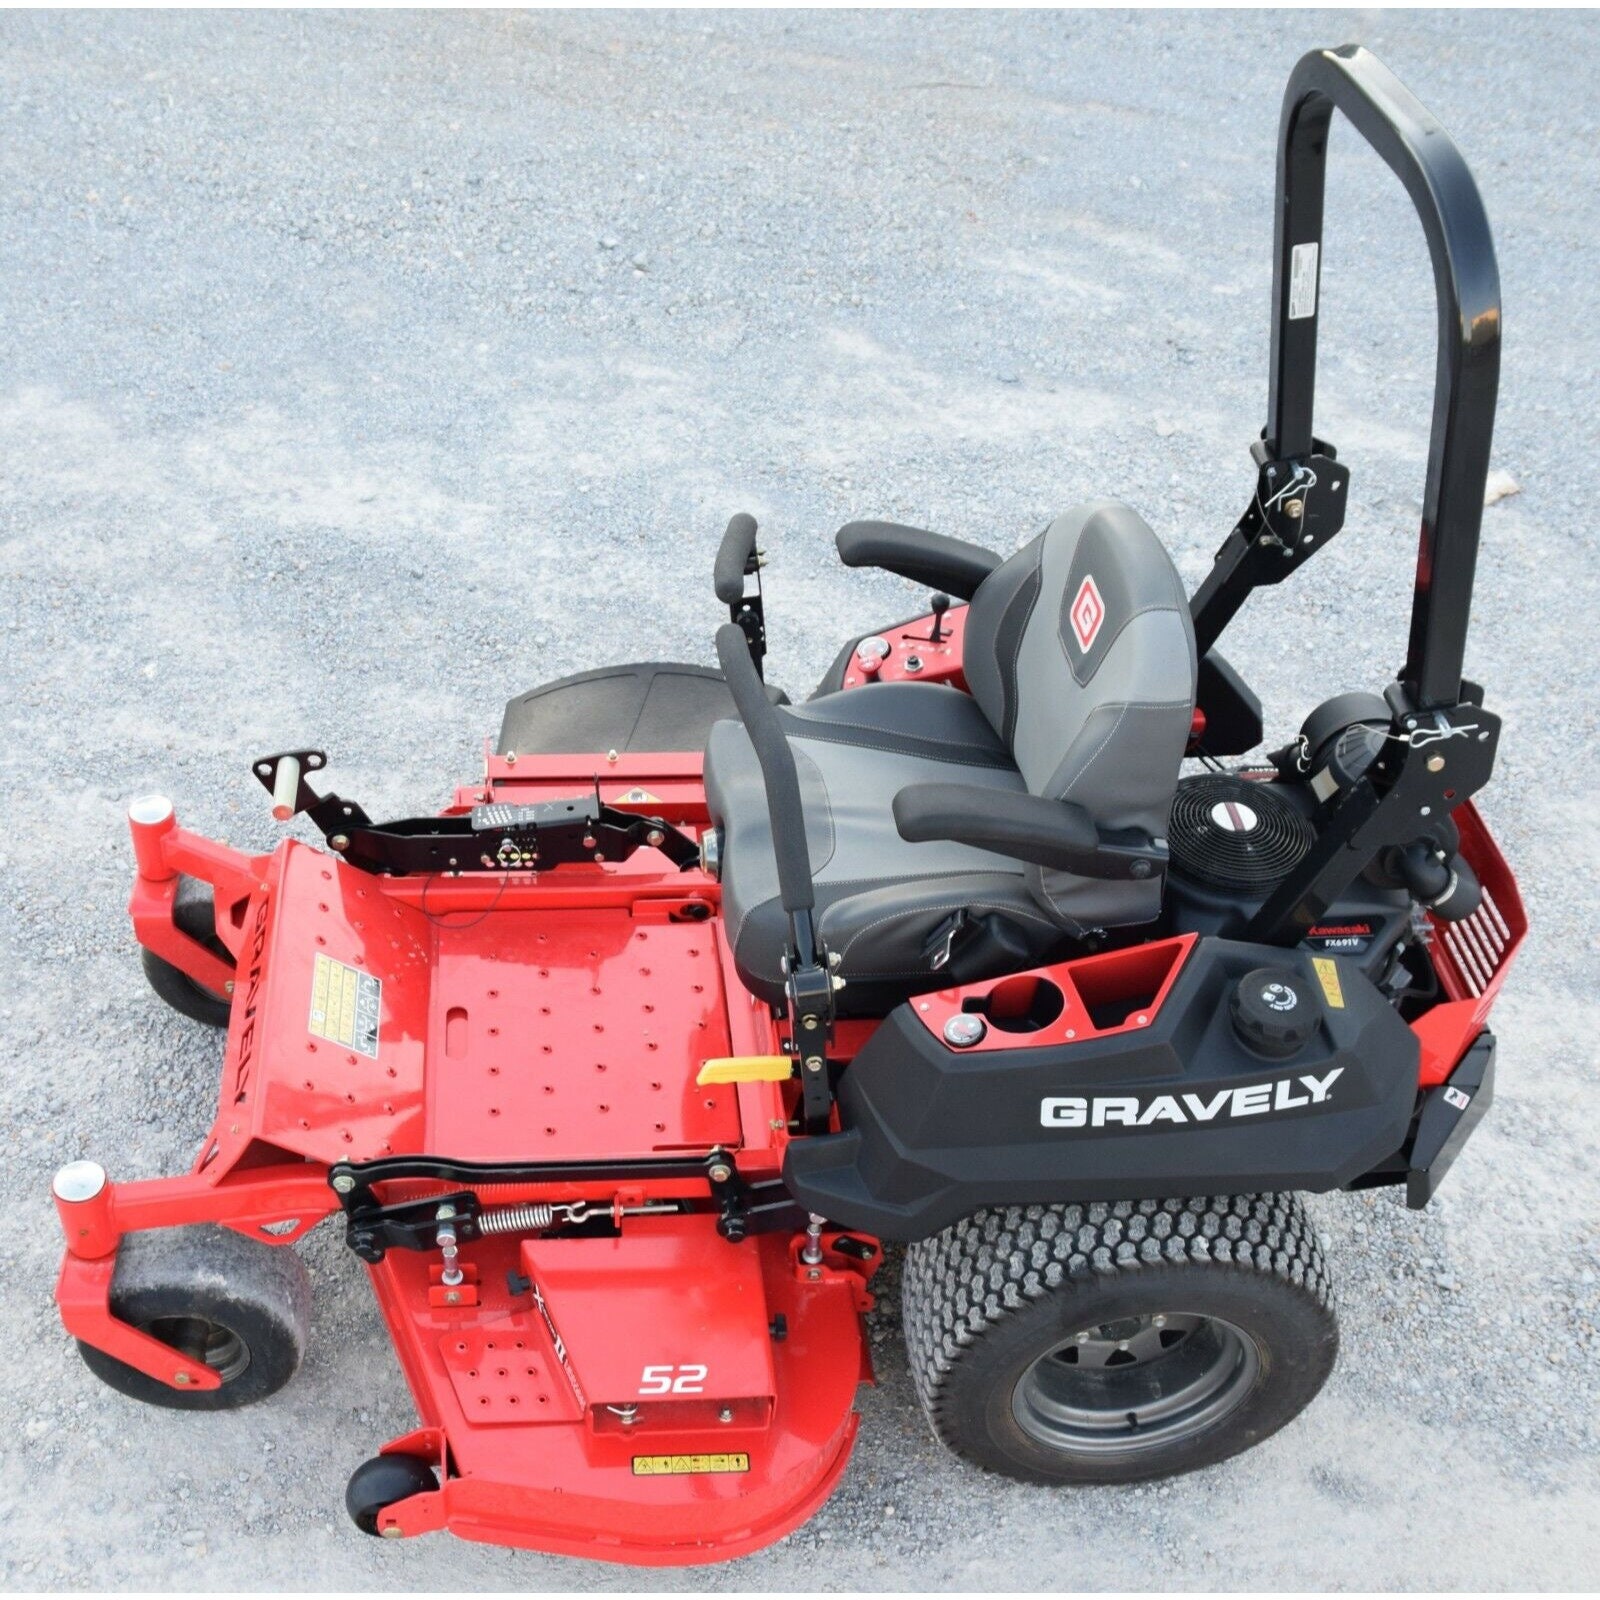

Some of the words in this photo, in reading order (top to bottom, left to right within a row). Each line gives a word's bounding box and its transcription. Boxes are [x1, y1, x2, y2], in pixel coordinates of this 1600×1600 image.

[1308, 923, 1371, 936] Kawasaki
[1325, 938, 1359, 947] FX691V
[1040, 1066, 1345, 1128] GRAVELY
[638, 1364, 708, 1394] 52
